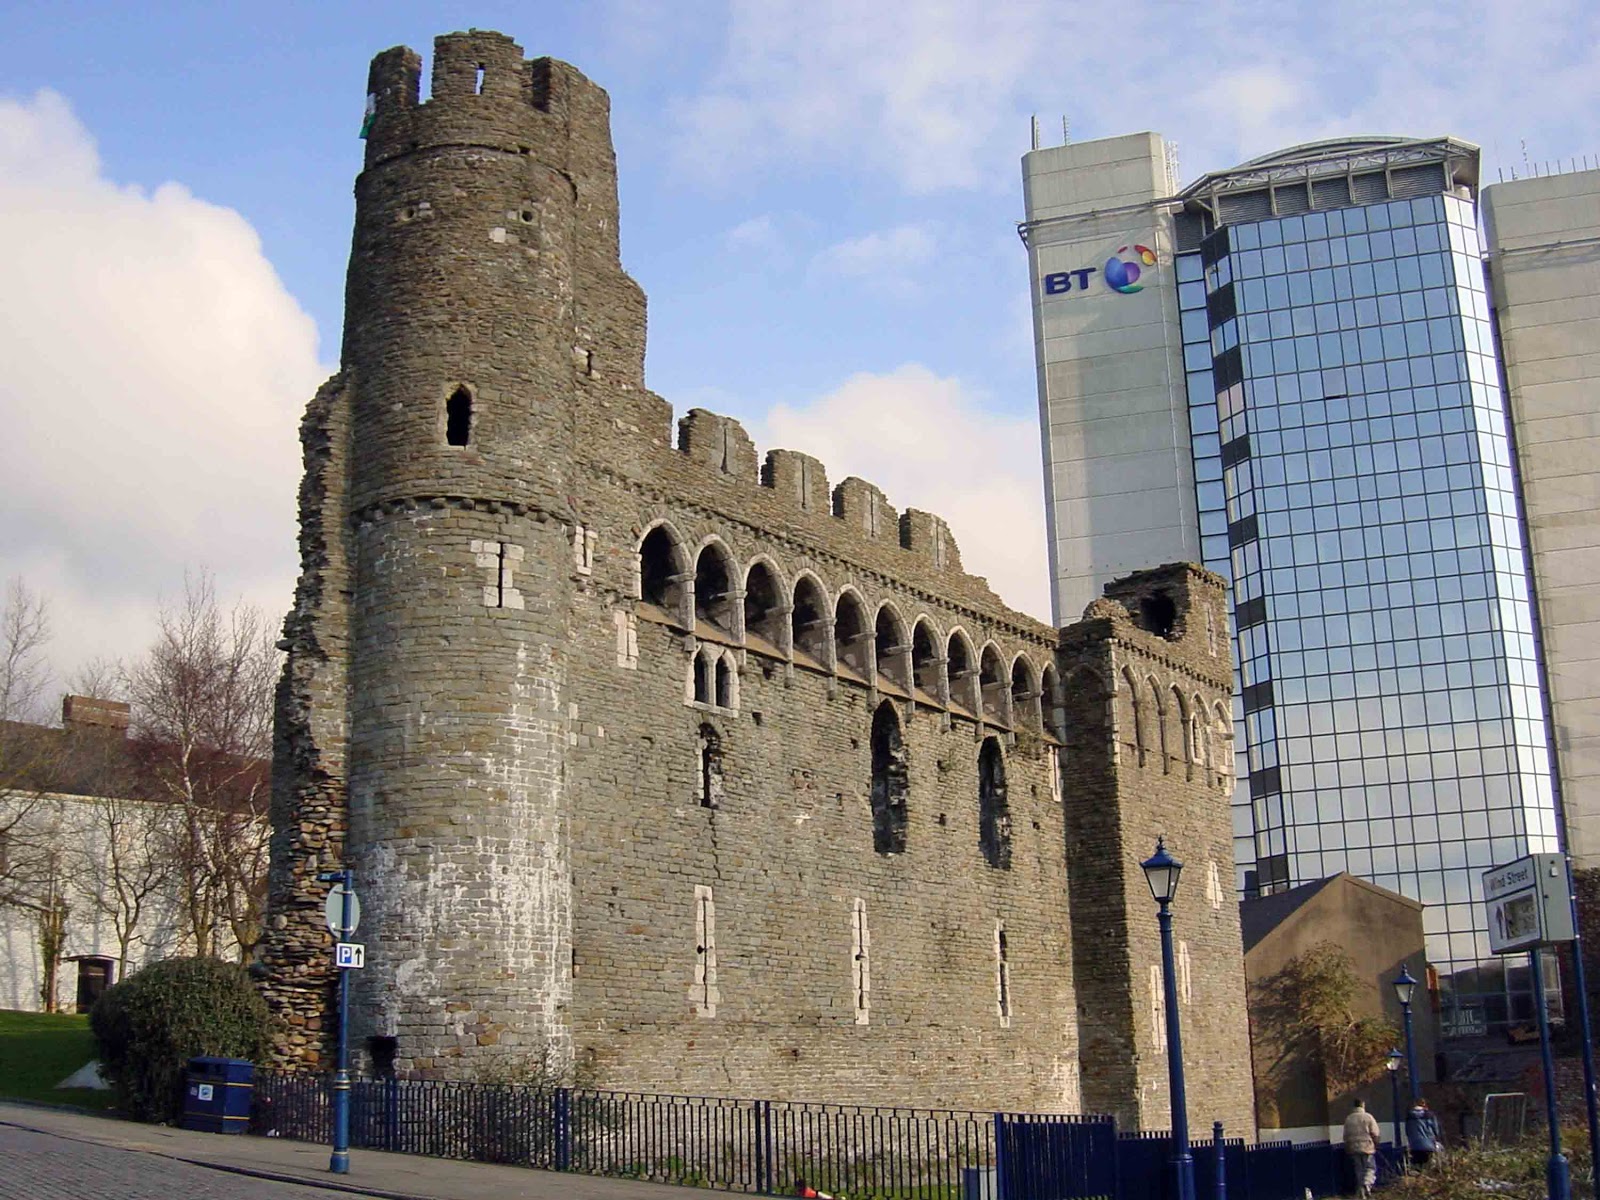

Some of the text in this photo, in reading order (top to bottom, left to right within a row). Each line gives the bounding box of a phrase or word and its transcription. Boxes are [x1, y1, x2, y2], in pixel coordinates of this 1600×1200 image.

[1044, 267, 1096, 294] BT
[1507, 867, 1528, 885] Street
[341, 947, 351, 963] P
